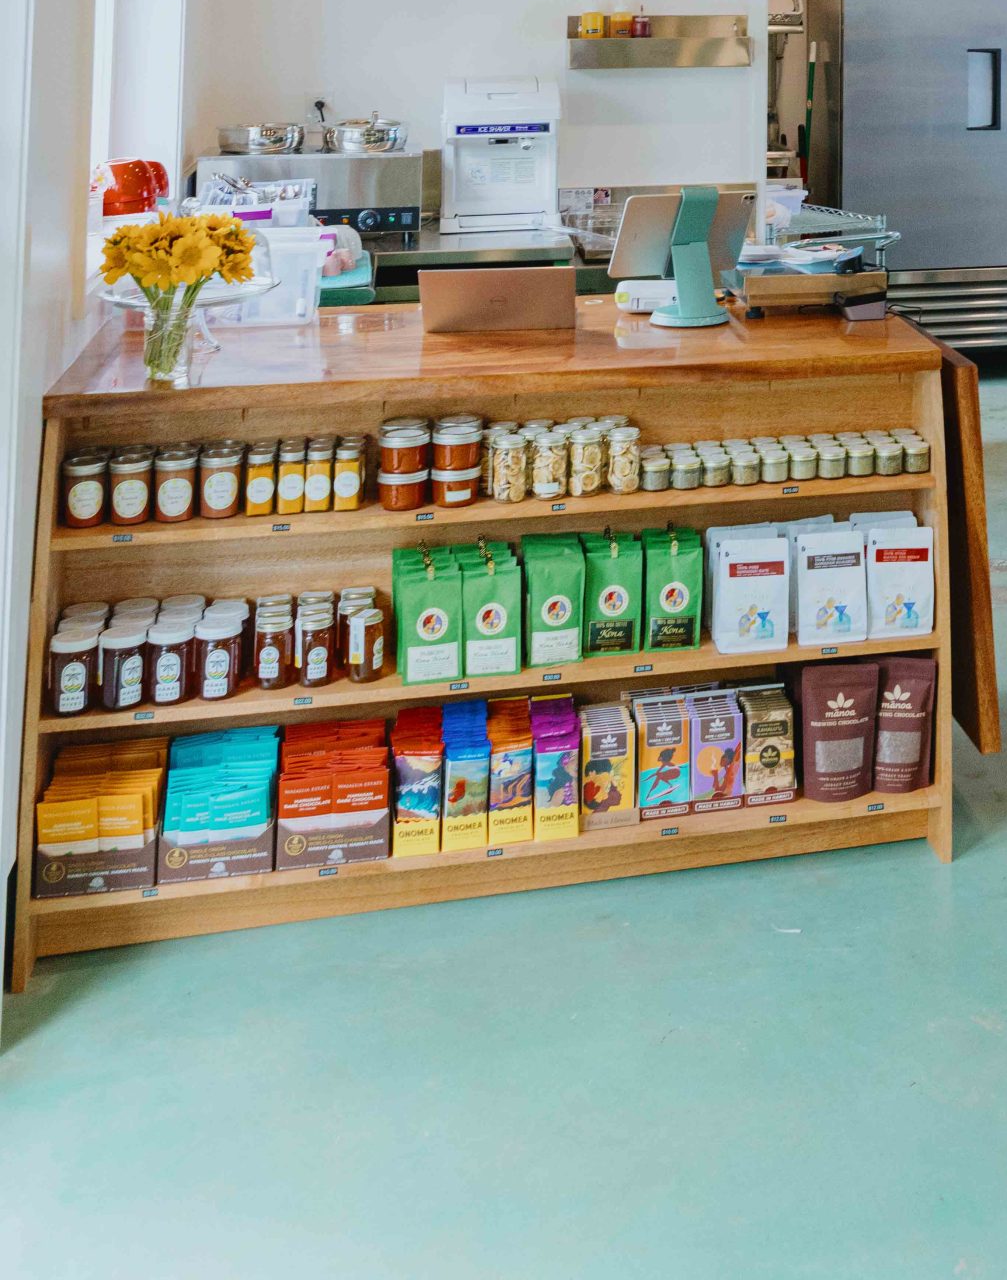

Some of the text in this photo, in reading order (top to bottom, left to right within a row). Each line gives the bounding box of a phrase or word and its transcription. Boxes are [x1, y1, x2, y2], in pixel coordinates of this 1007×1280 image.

[600, 628, 625, 638] Kona
[660, 625, 685, 635] Kona
[493, 815, 528, 826] ONOMEA
[539, 812, 574, 823] ONOMEA
[448, 821, 482, 832] ONOMEA
[398, 828, 434, 838] ONOMEA
